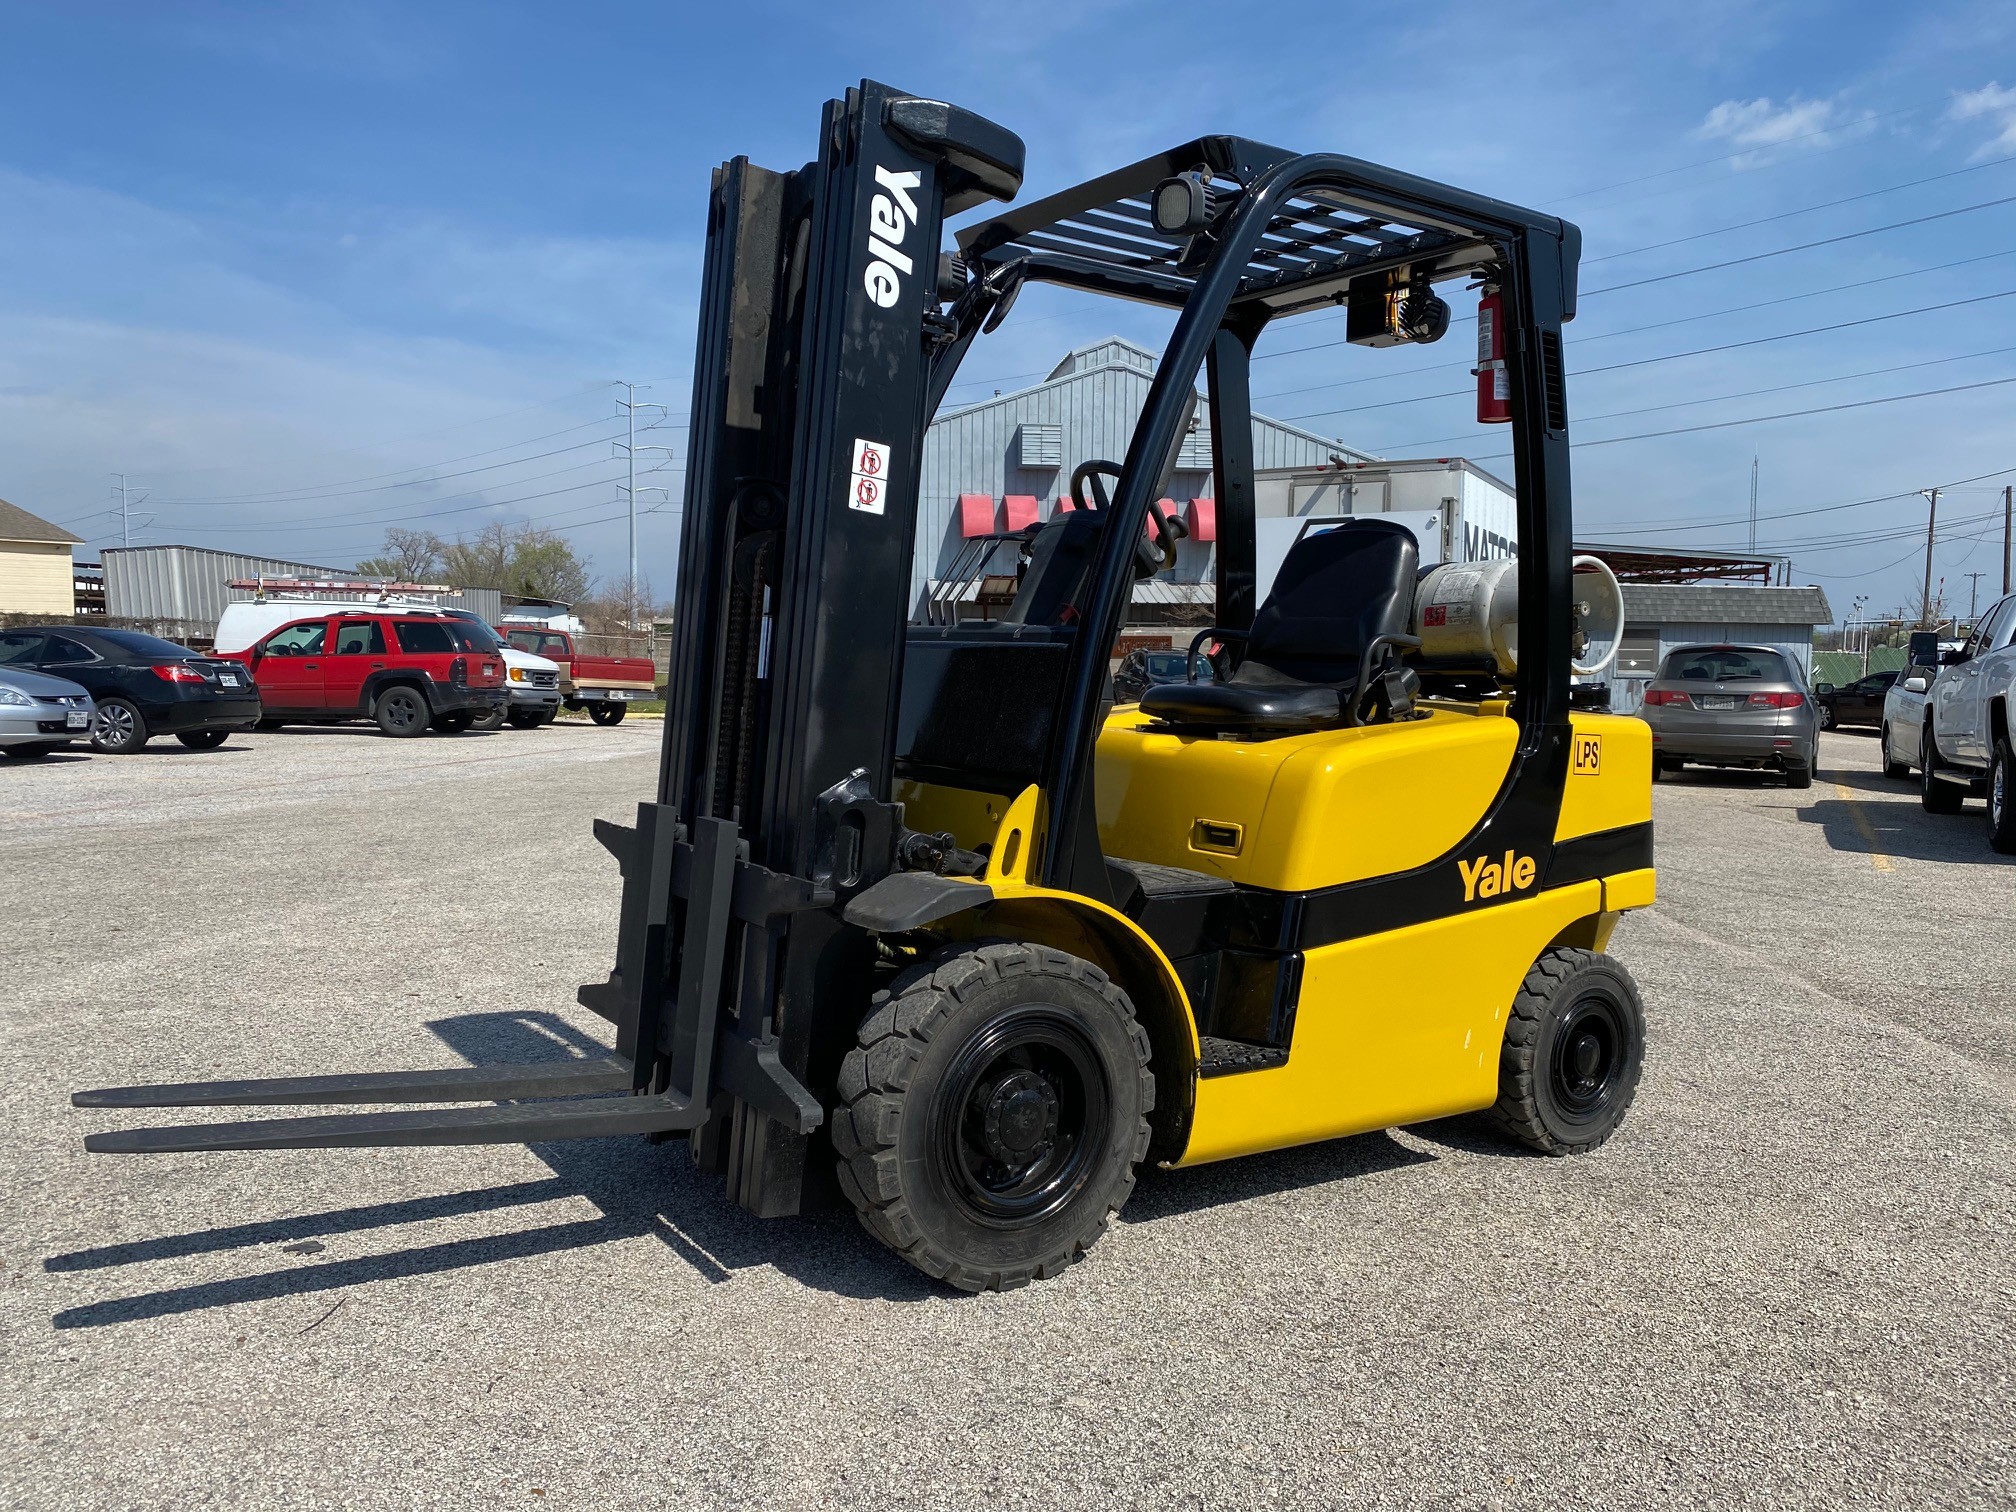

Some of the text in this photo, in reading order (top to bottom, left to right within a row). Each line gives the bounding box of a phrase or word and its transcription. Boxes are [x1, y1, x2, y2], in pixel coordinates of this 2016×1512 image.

[864, 164, 921, 308] Yale
[1576, 740, 1599, 769] LPS
[1457, 849, 1536, 902] Yale
